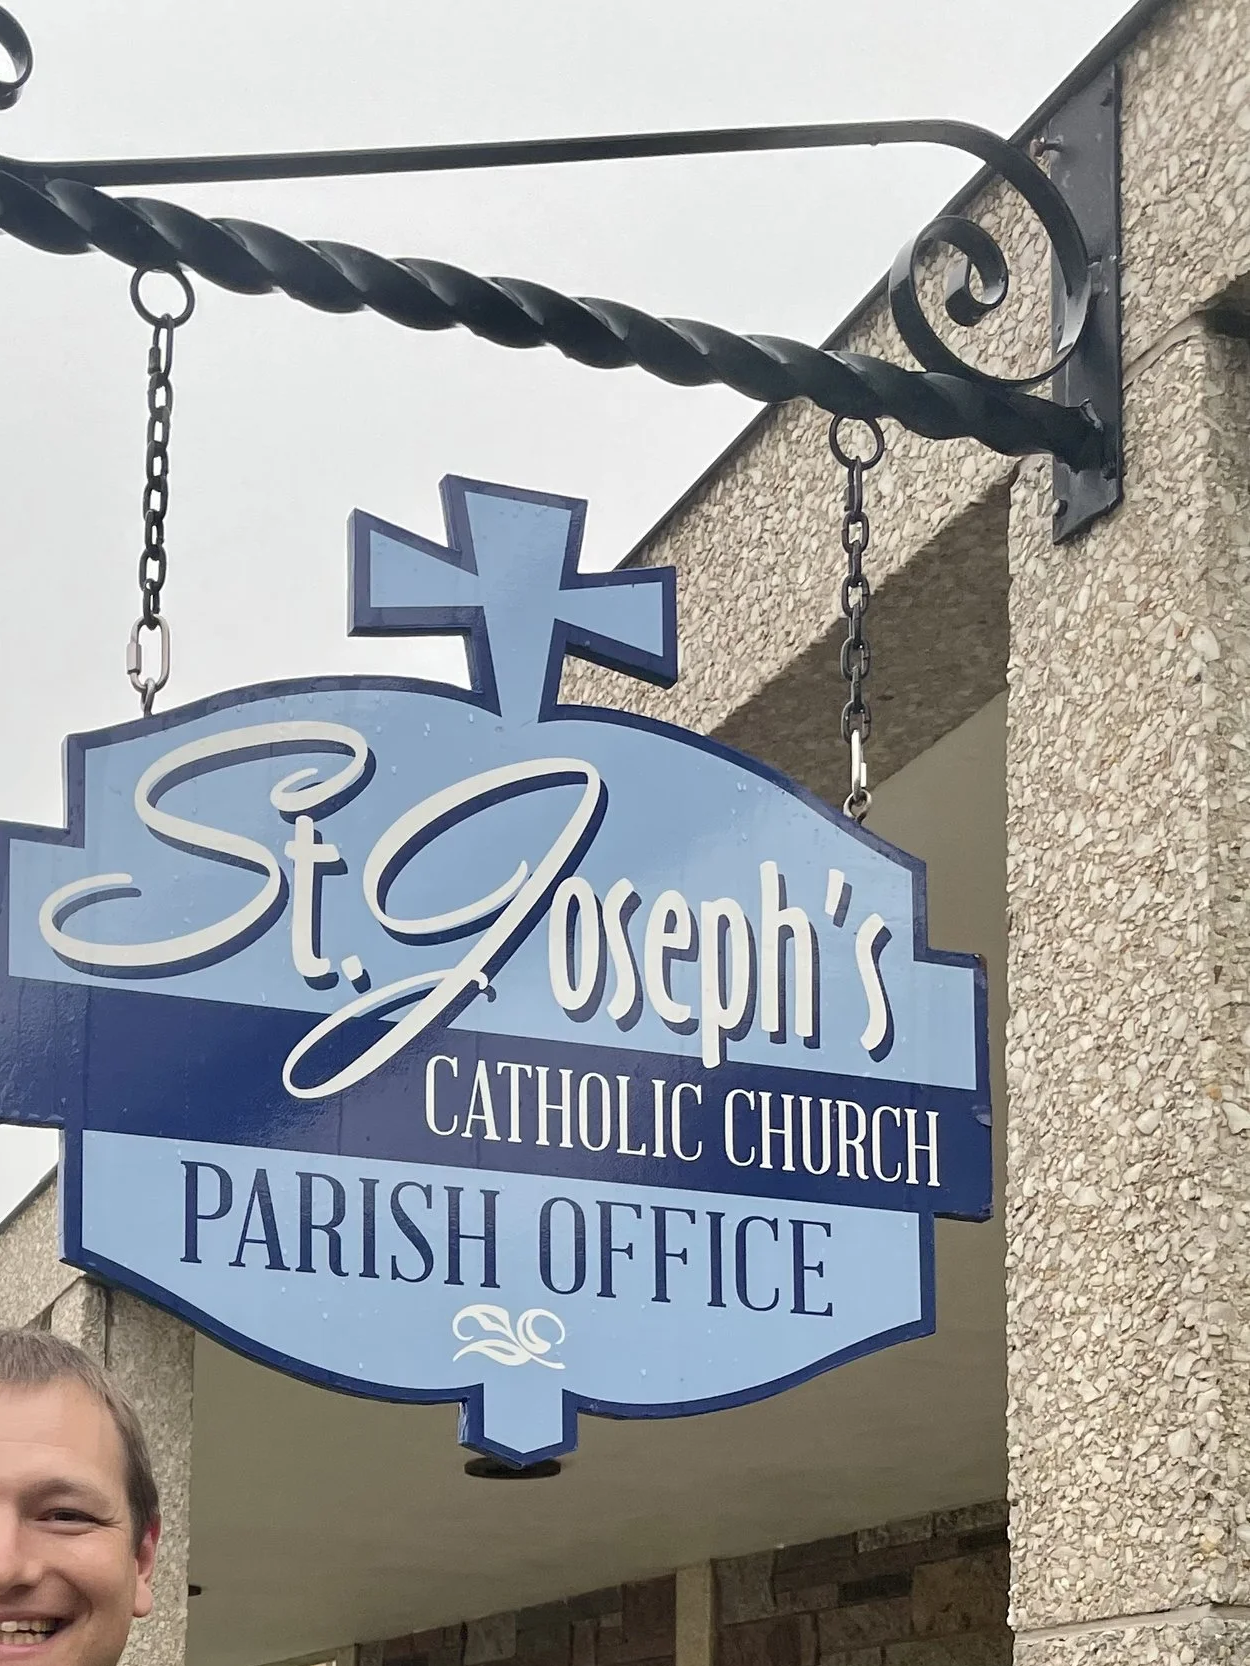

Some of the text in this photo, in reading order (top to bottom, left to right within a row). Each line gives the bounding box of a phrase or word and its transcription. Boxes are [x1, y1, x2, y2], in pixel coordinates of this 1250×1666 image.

[38, 720, 888, 1101] St. Joseph's
[424, 1054, 942, 1189] CATHOLIC CHURCH
[179, 1159, 835, 1318] PARISH OFFICE
